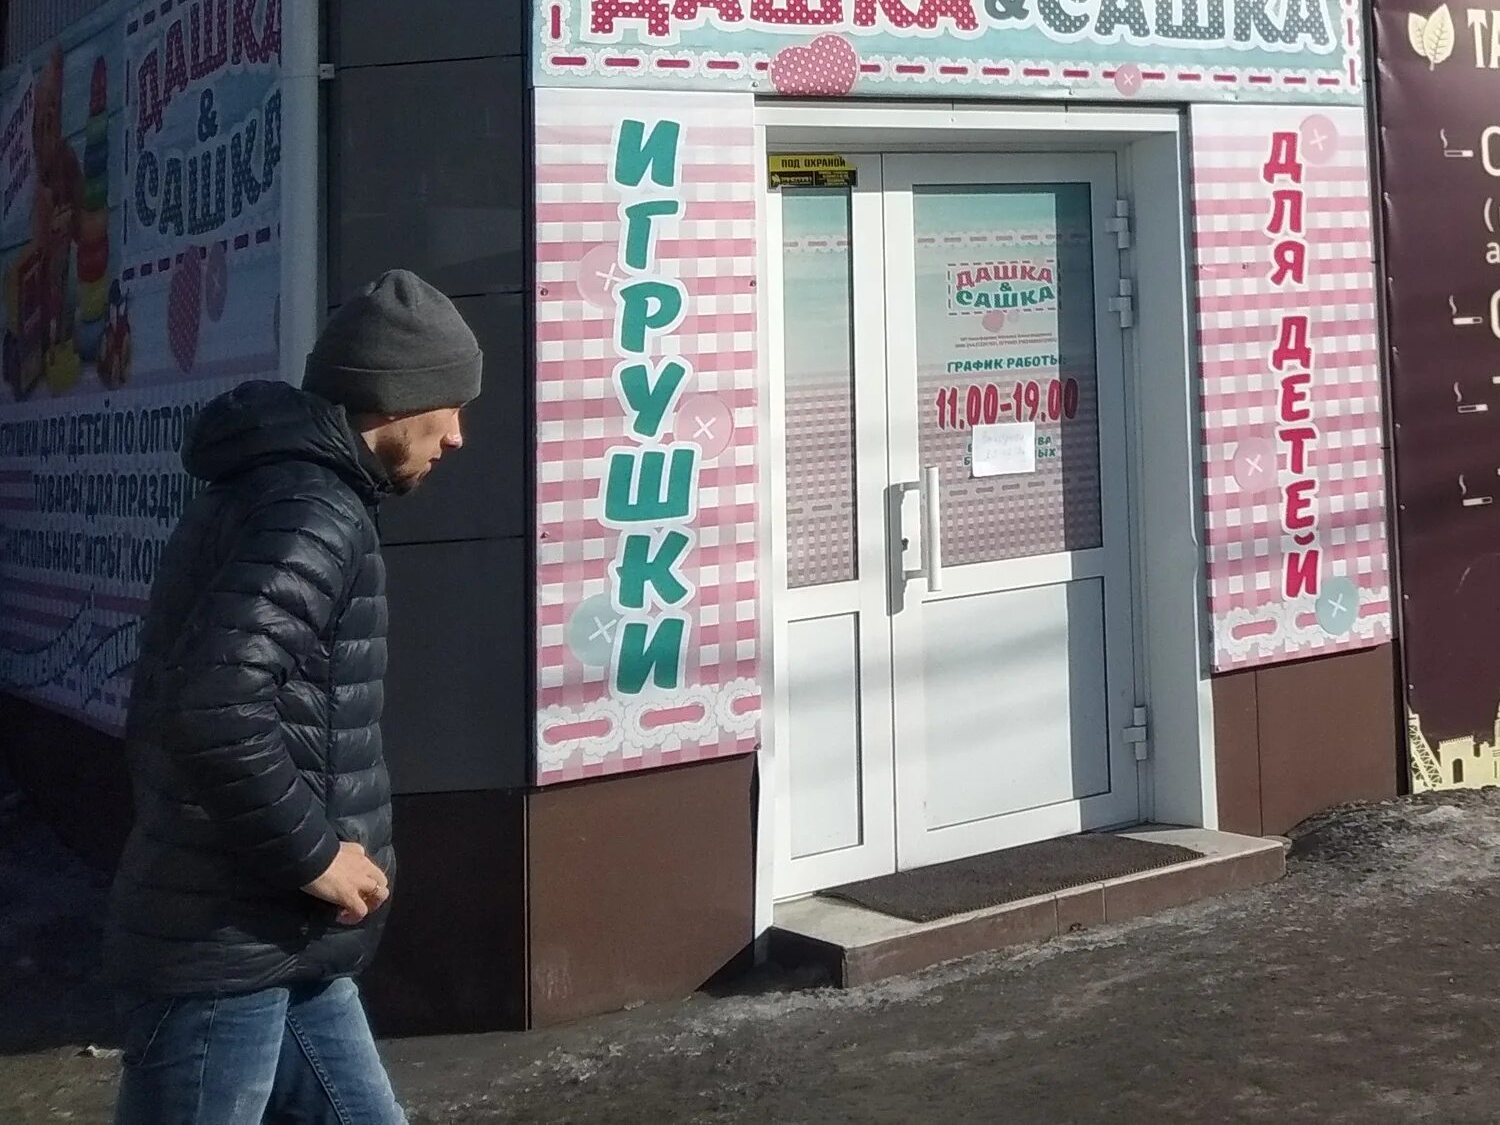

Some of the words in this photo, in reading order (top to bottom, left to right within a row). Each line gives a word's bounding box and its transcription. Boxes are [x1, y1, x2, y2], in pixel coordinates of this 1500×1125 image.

[198, 88, 218, 142] &
[135, 88, 281, 236] САШКА
[781, 159, 800, 168] ПОД
[804, 157, 846, 168] ОХРАНОЙ
[1264, 131, 1306, 287] ДЛЯ
[956, 265, 1053, 290] ДАШКА
[956, 286, 1055, 308] САШКА
[1000, 282, 1012, 292] &
[947, 359, 1003, 373] ГРАФИК
[114, 410, 135, 455] ПО
[139, 402, 200, 454] ОПТО
[607, 120, 698, 692] ИГРУШКИ
[936, 378, 1078, 430] 11.00-19.00
[1272, 315, 1319, 601] ДЕТЕЙ
[117, 473, 198, 528] ПРАЗДН
